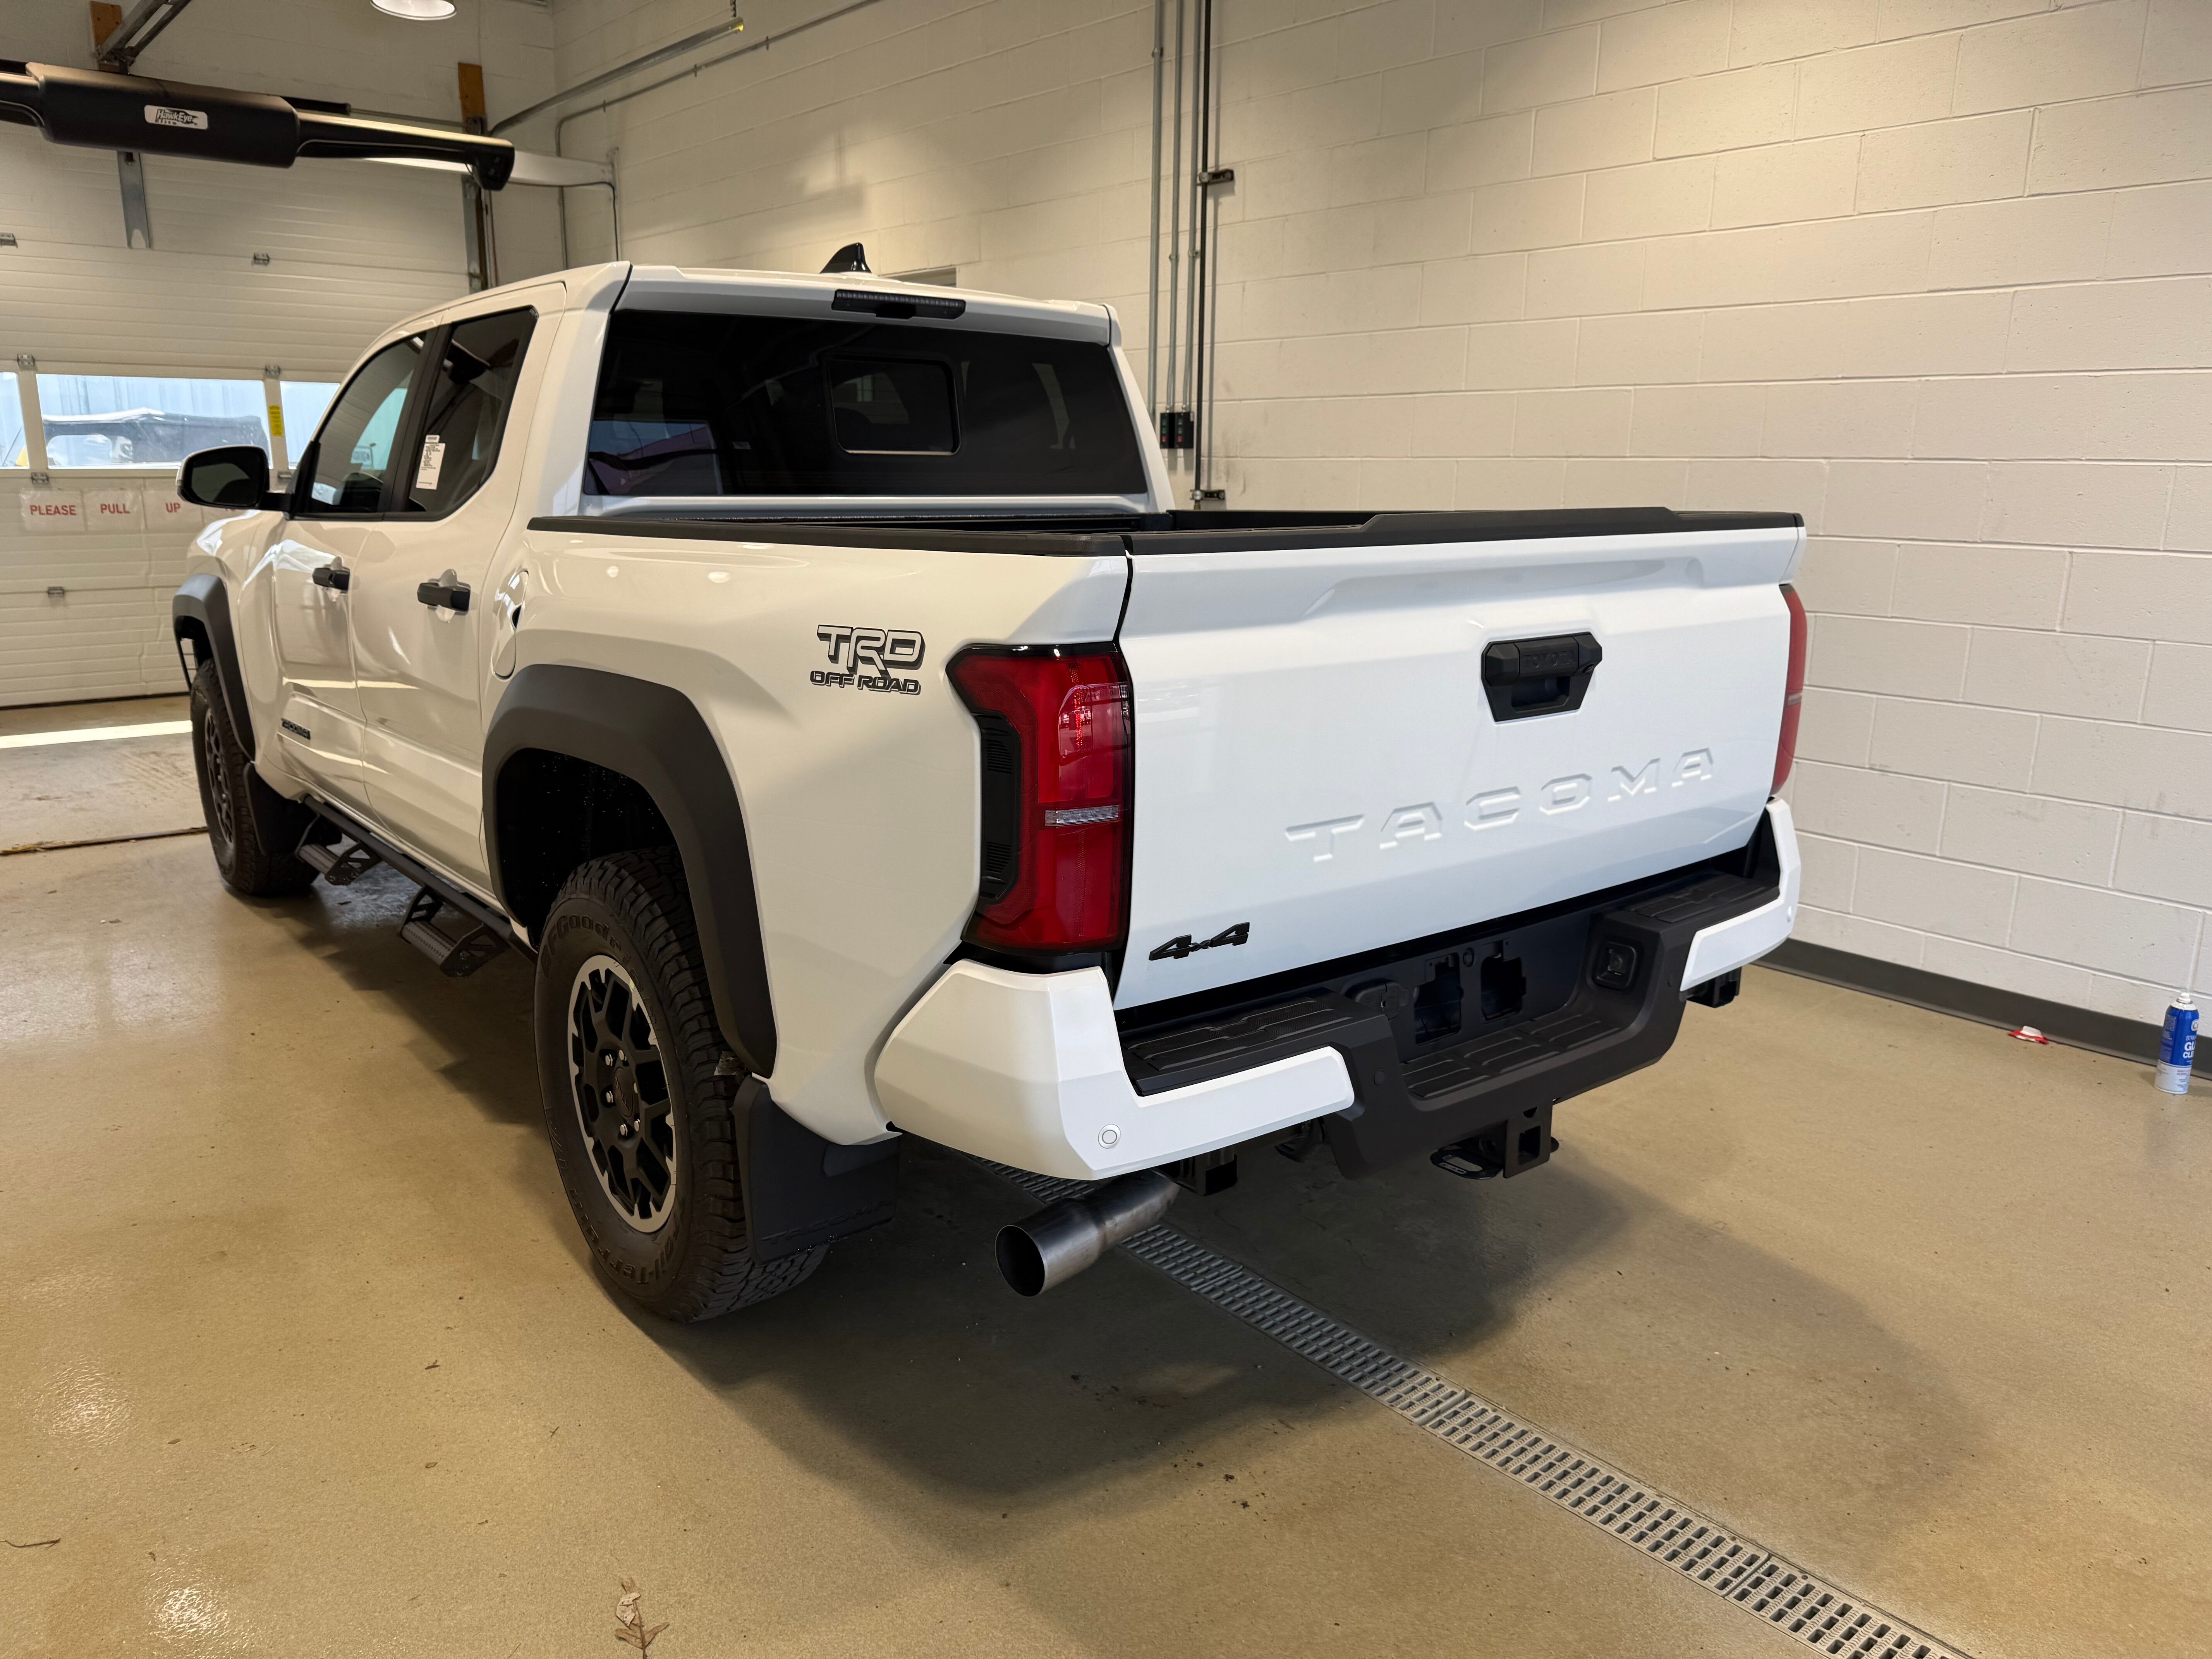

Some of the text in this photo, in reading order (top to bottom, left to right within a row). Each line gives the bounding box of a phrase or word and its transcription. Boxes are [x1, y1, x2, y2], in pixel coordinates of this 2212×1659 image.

[156, 109, 193, 123] HawkEye
[30, 502, 180, 515] PLEASE PULL UP
[817, 624, 926, 678] TRD
[1522, 651, 1577, 670] TOYOTA
[810, 670, 921, 696] OFF ROAD
[1285, 747, 1714, 863] TACOMA
